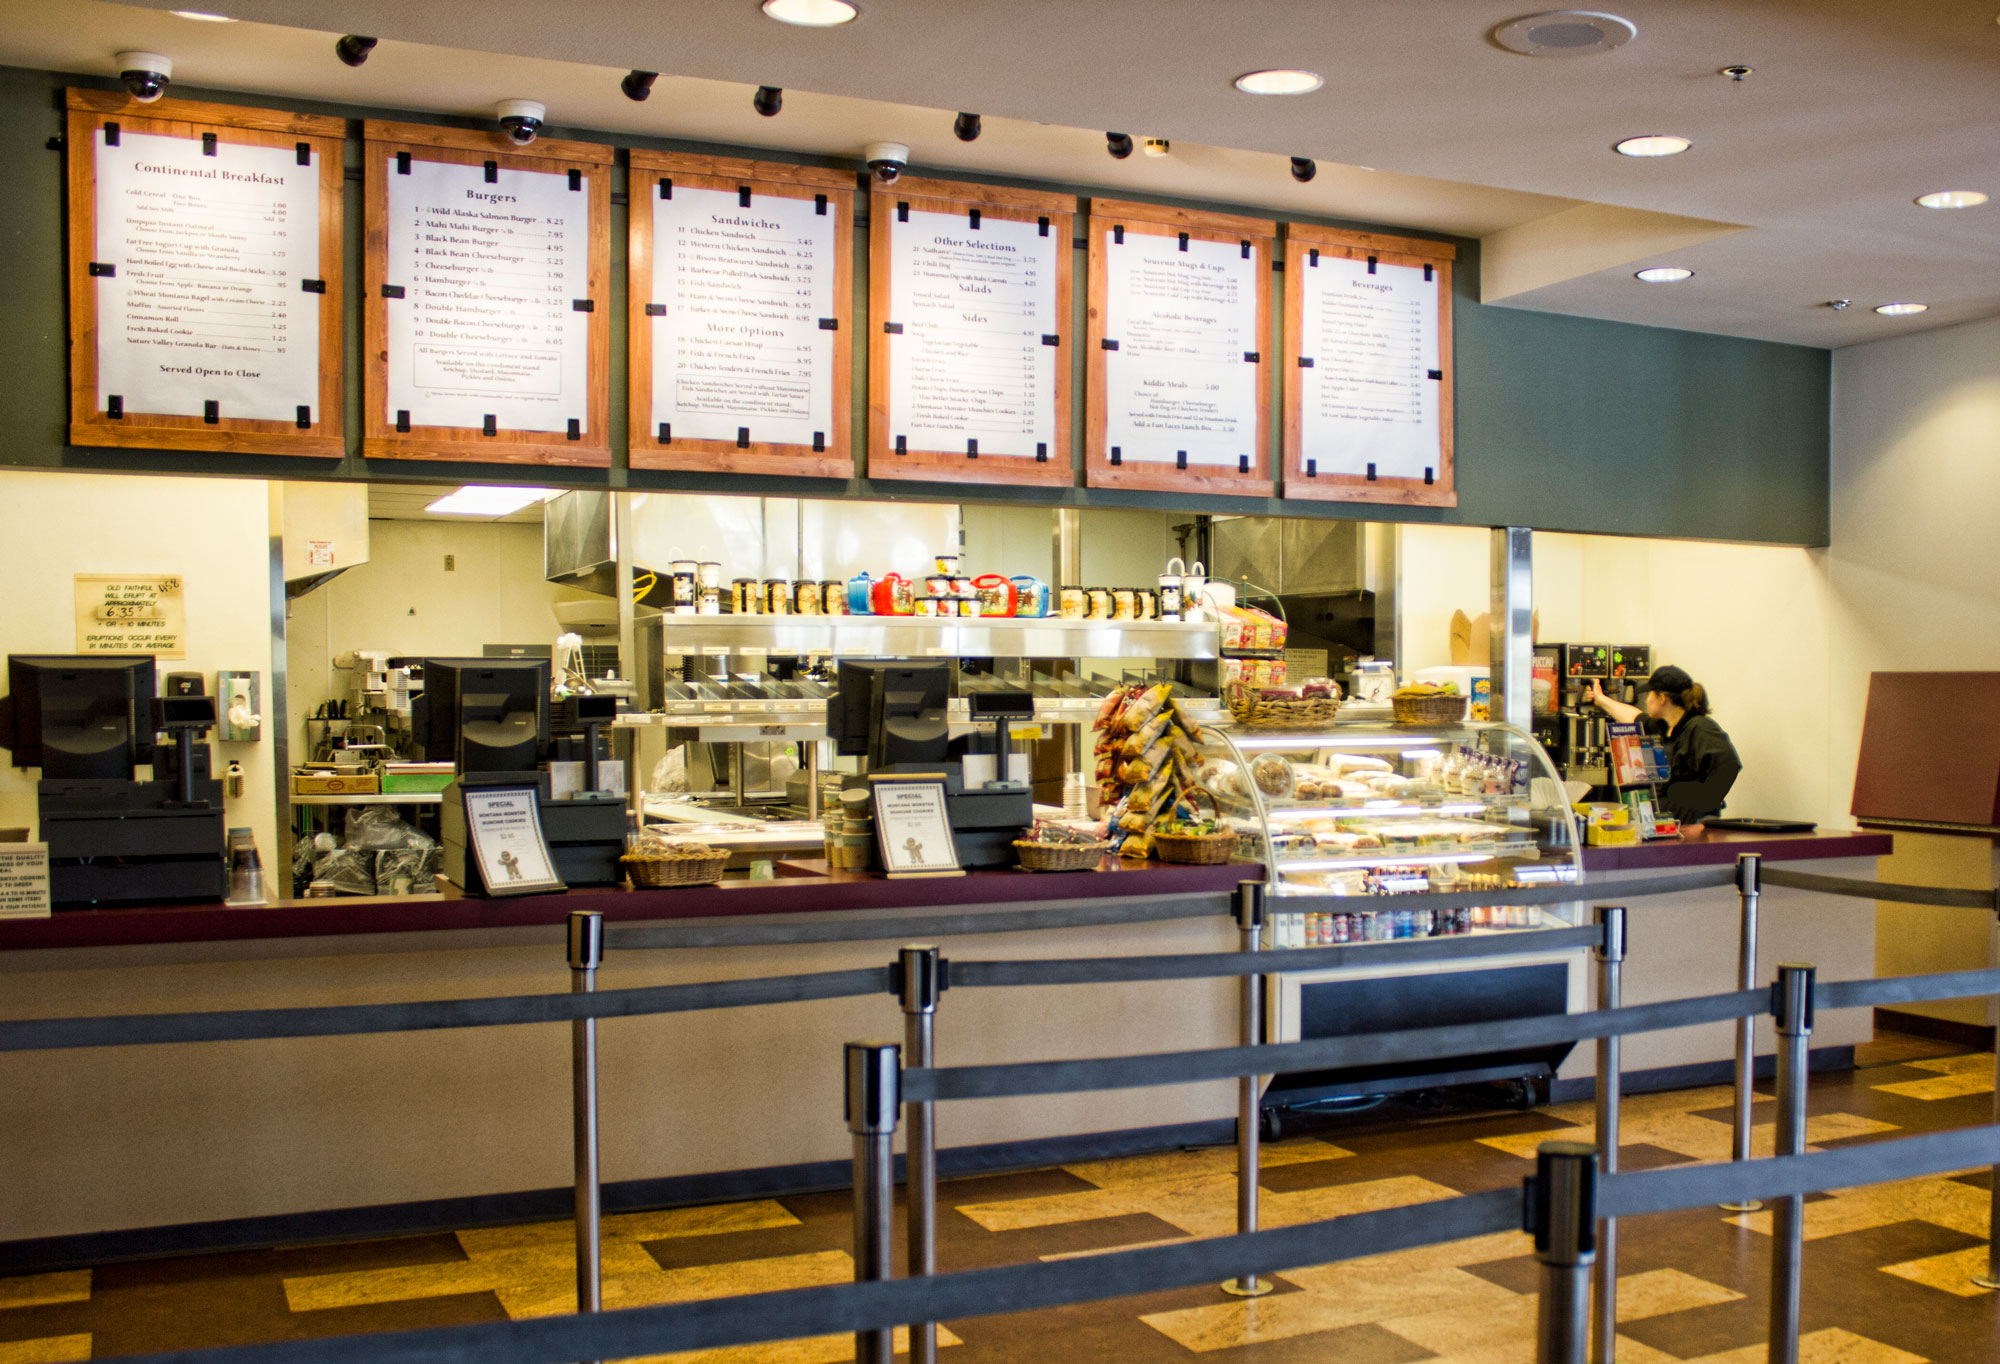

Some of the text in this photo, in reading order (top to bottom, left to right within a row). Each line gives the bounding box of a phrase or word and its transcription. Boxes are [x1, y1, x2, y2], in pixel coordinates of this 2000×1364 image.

[134, 161, 284, 185] Continental Breakfast
[466, 189, 517, 204] Burgers
[431, 207, 450, 215] Wild
[453, 208, 478, 218] Alaska
[479, 211, 509, 220] Salmon
[510, 214, 536, 225] Burger
[546, 217, 563, 225] 8.25
[712, 215, 781, 230] Sandwiches
[425, 220, 447, 228] Mahi
[449, 222, 470, 230] Mahi
[472, 224, 499, 235] Burger
[547, 230, 563, 238] 7.95
[690, 226, 719, 236] Chicken
[721, 229, 755, 239] Sandwich
[425, 233, 447, 242] Black
[449, 235, 469, 244] Bean
[471, 237, 499, 248] Burger
[547, 243, 563, 252] 4.95
[690, 240, 720, 249] Western
[721, 243, 750, 252] Chicken
[751, 245, 786, 255] Sandwich
[796, 250, 812, 258] 6.25
[934, 236, 1016, 252] Other Selections
[425, 247, 447, 256] Black
[449, 249, 469, 258] Bean
[471, 251, 524, 264] Cheeseburger
[425, 261, 479, 275] Cheeseburger
[755, 259, 789, 268] Sandwich
[1144, 257, 1176, 266] Souvenir
[1178, 260, 1198, 270] Mugs
[1208, 264, 1225, 272] Cups
[425, 275, 471, 288] Hamburger
[959, 283, 992, 294] Salads
[1352, 280, 1393, 293] Beverages
[191, 294, 209, 302] Bagel
[126, 313, 163, 321] Cinnamon
[962, 313, 988, 323] Sides
[429, 330, 457, 338] Double
[707, 323, 784, 339] More Options
[152, 339, 173, 347] Valley
[160, 364, 261, 378] Served Open to Close
[689, 362, 716, 370] Chicken
